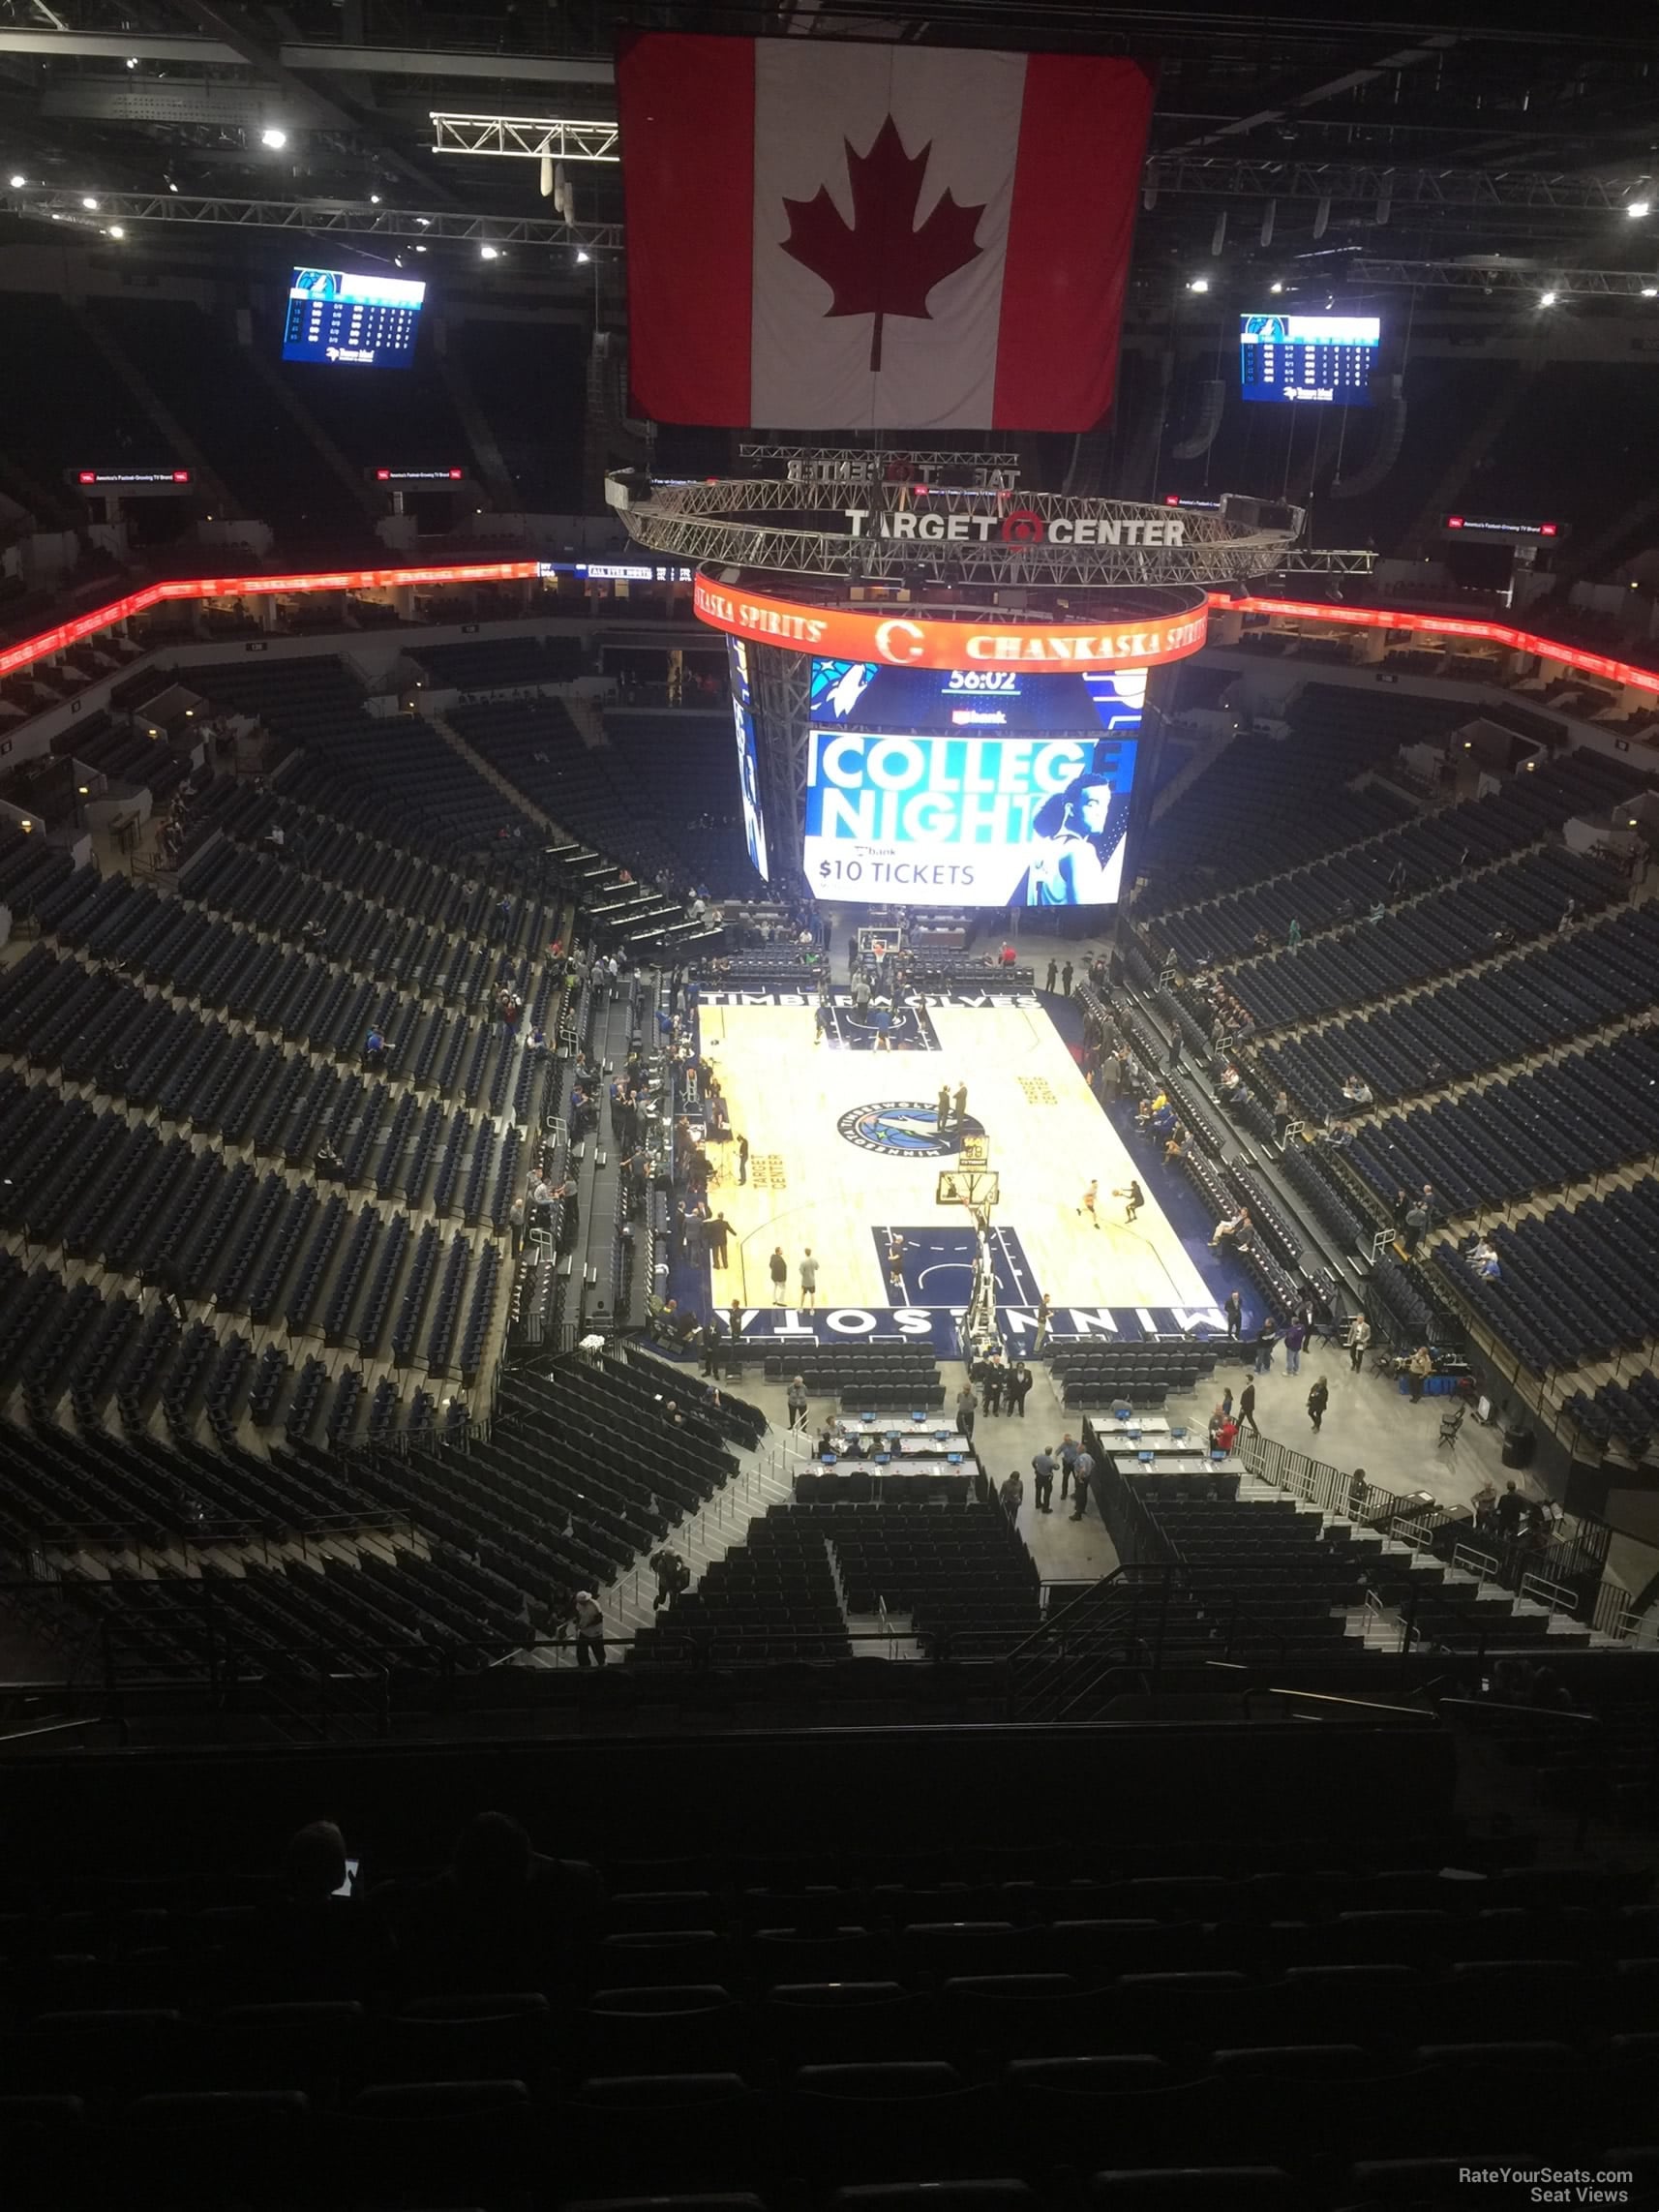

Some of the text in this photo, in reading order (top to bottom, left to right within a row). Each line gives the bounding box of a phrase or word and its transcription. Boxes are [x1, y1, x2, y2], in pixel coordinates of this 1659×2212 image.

[1047, 519, 1184, 547] CENTER
[695, 588, 828, 643] KASKA SPIRITS
[966, 633, 1161, 660] CHANKASKA
[949, 670, 1016, 690] 56:02
[822, 734, 1123, 794] COLLEGE
[821, 788, 1041, 843] NIGHT
[819, 860, 975, 885] $10 TICKETS
[750, 1154, 768, 1190] TARGET
[768, 1154, 787, 1190] CENTER
